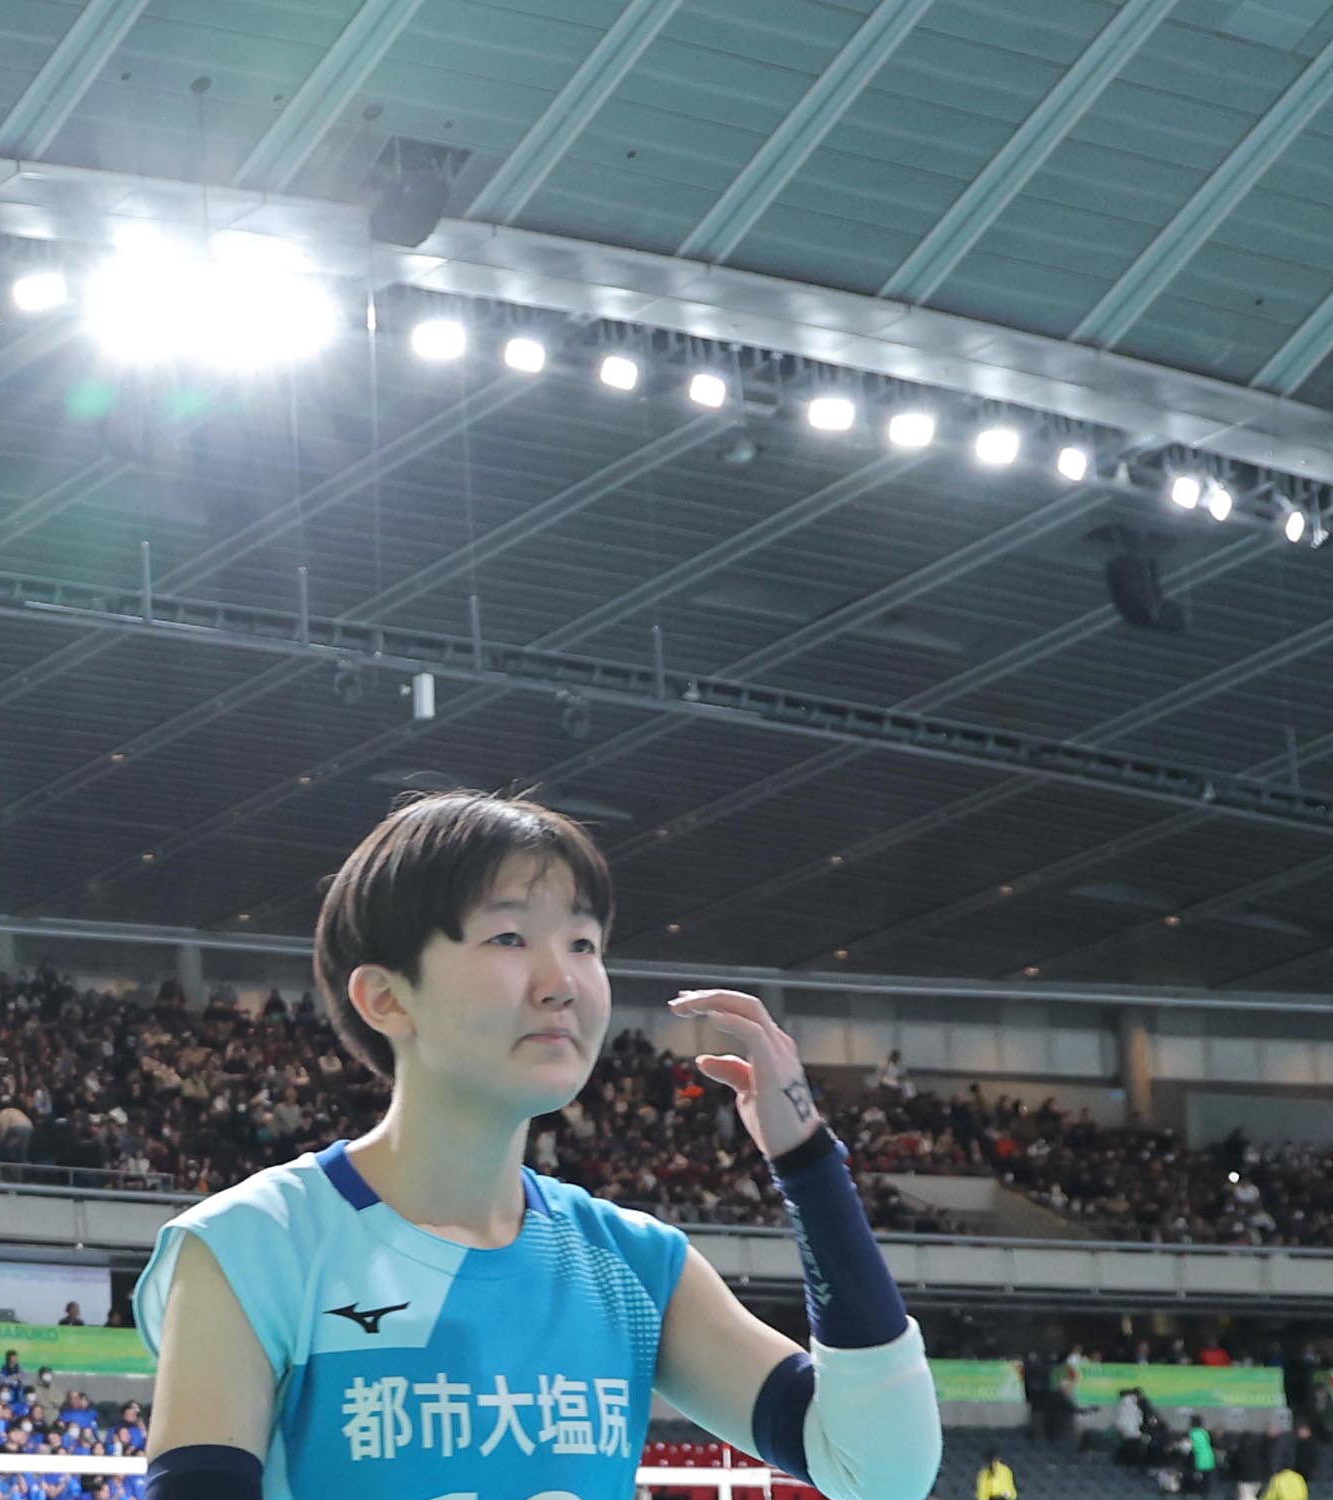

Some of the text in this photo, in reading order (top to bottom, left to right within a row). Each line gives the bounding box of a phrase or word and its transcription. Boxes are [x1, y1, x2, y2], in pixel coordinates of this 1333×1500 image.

[342, 1373, 631, 1461] 都市大塩尻
